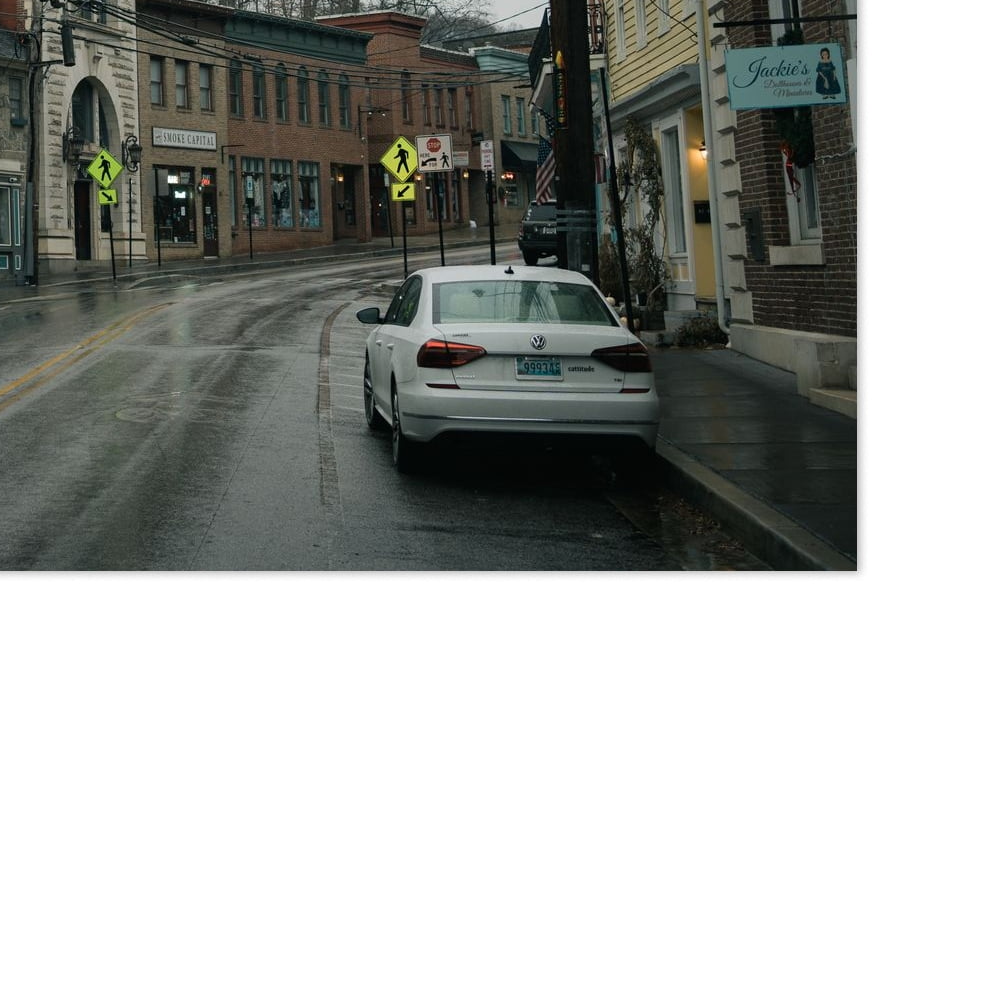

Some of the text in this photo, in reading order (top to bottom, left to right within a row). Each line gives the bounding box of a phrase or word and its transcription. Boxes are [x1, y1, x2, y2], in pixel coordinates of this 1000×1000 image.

[733, 56, 808, 88] Jackie's
[163, 132, 214, 146] SMOKE CAPITAL
